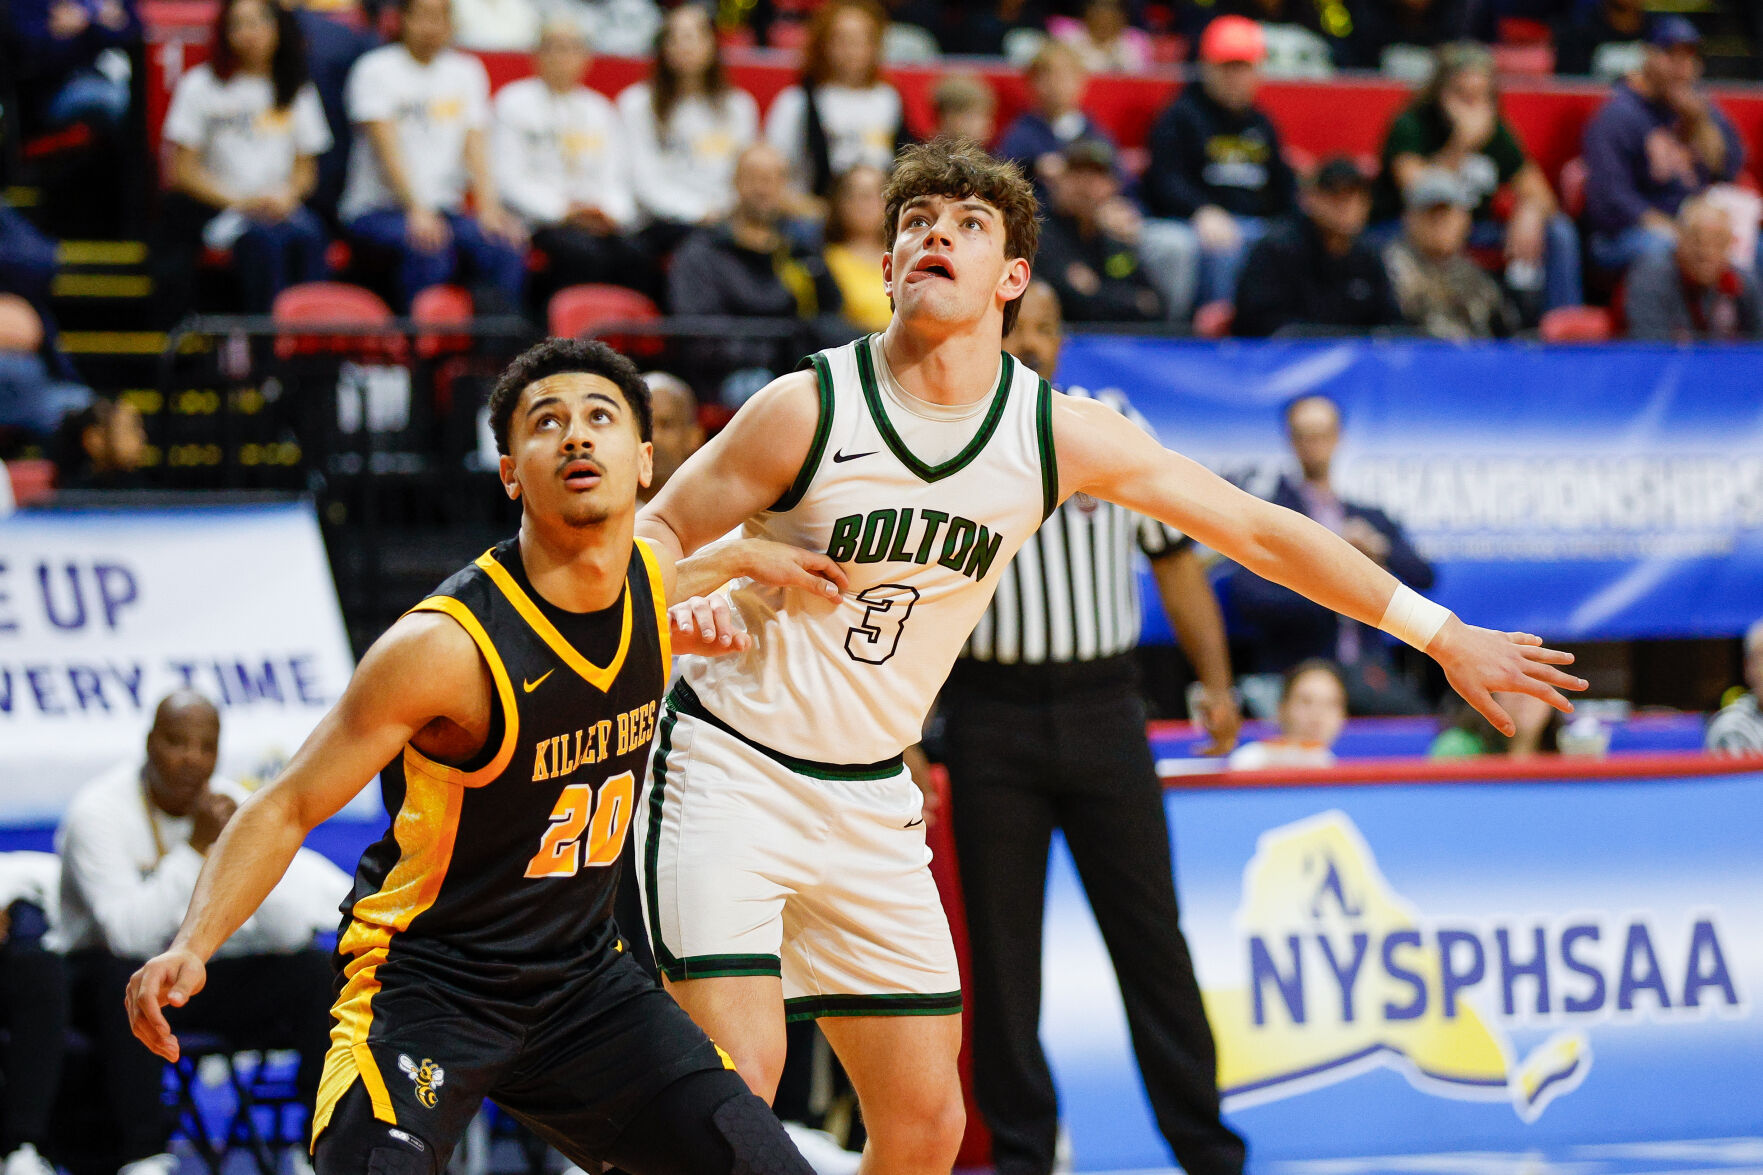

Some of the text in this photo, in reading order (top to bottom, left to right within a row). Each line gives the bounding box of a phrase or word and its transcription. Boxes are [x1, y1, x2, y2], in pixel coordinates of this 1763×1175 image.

[826, 508, 1003, 582] BOLTON
[37, 561, 139, 632] UP
[844, 584, 920, 665] 3
[167, 655, 326, 707] TIME
[532, 700, 656, 782] KILLER BEES
[523, 769, 635, 878] 20
[1249, 920, 1739, 1027] NYSPHSAA
